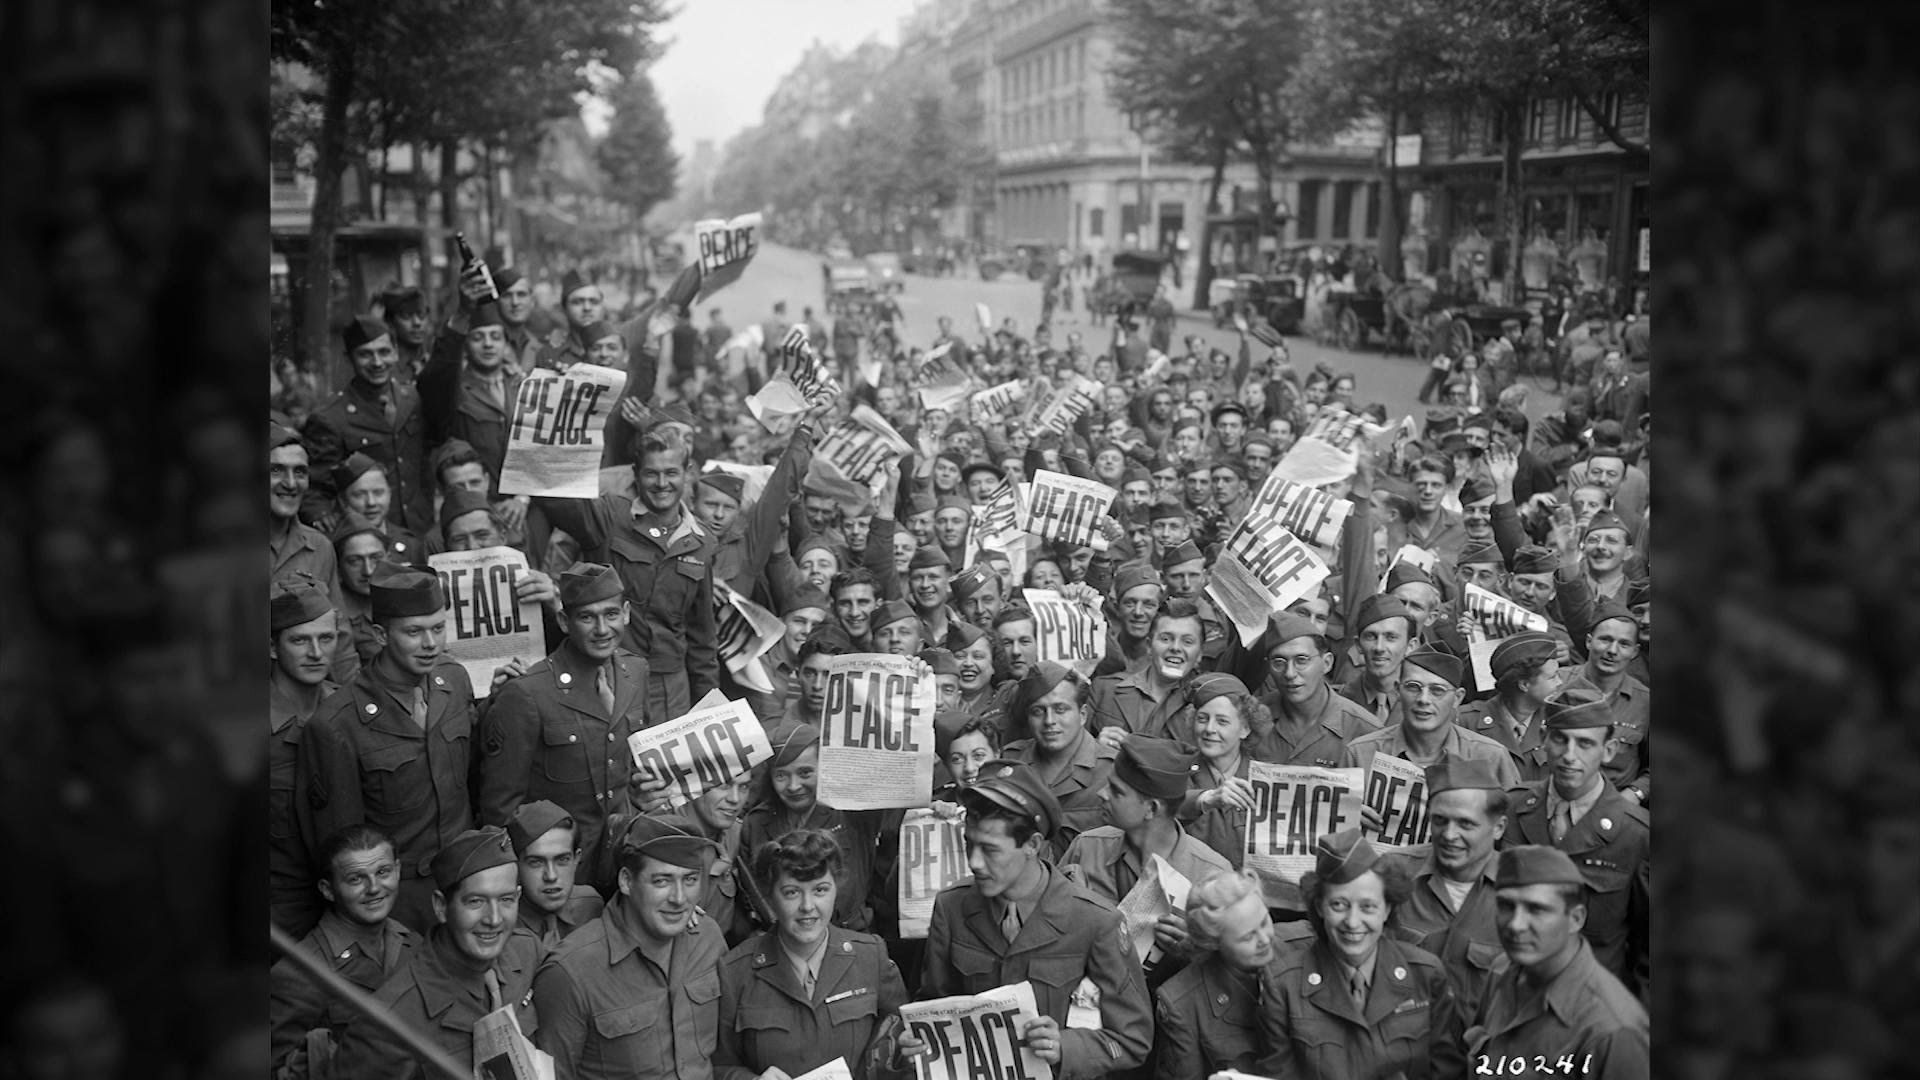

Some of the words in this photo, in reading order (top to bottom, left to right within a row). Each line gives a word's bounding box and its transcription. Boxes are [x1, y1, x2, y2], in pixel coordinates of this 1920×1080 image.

[700, 226, 755, 275] PEACE
[512, 376, 609, 445] PEACE
[1028, 483, 1105, 545] PEACE
[1255, 479, 1337, 547] PEACE
[1225, 511, 1317, 597] PEACE
[1034, 602, 1098, 660] PEACE
[823, 670, 920, 752] PEACE
[637, 717, 755, 799] PEACE
[1250, 781, 1349, 856] PEACE
[1366, 770, 1431, 846] PEA
[904, 822, 967, 899] PEA
[910, 1008, 1035, 1080] PEACE
